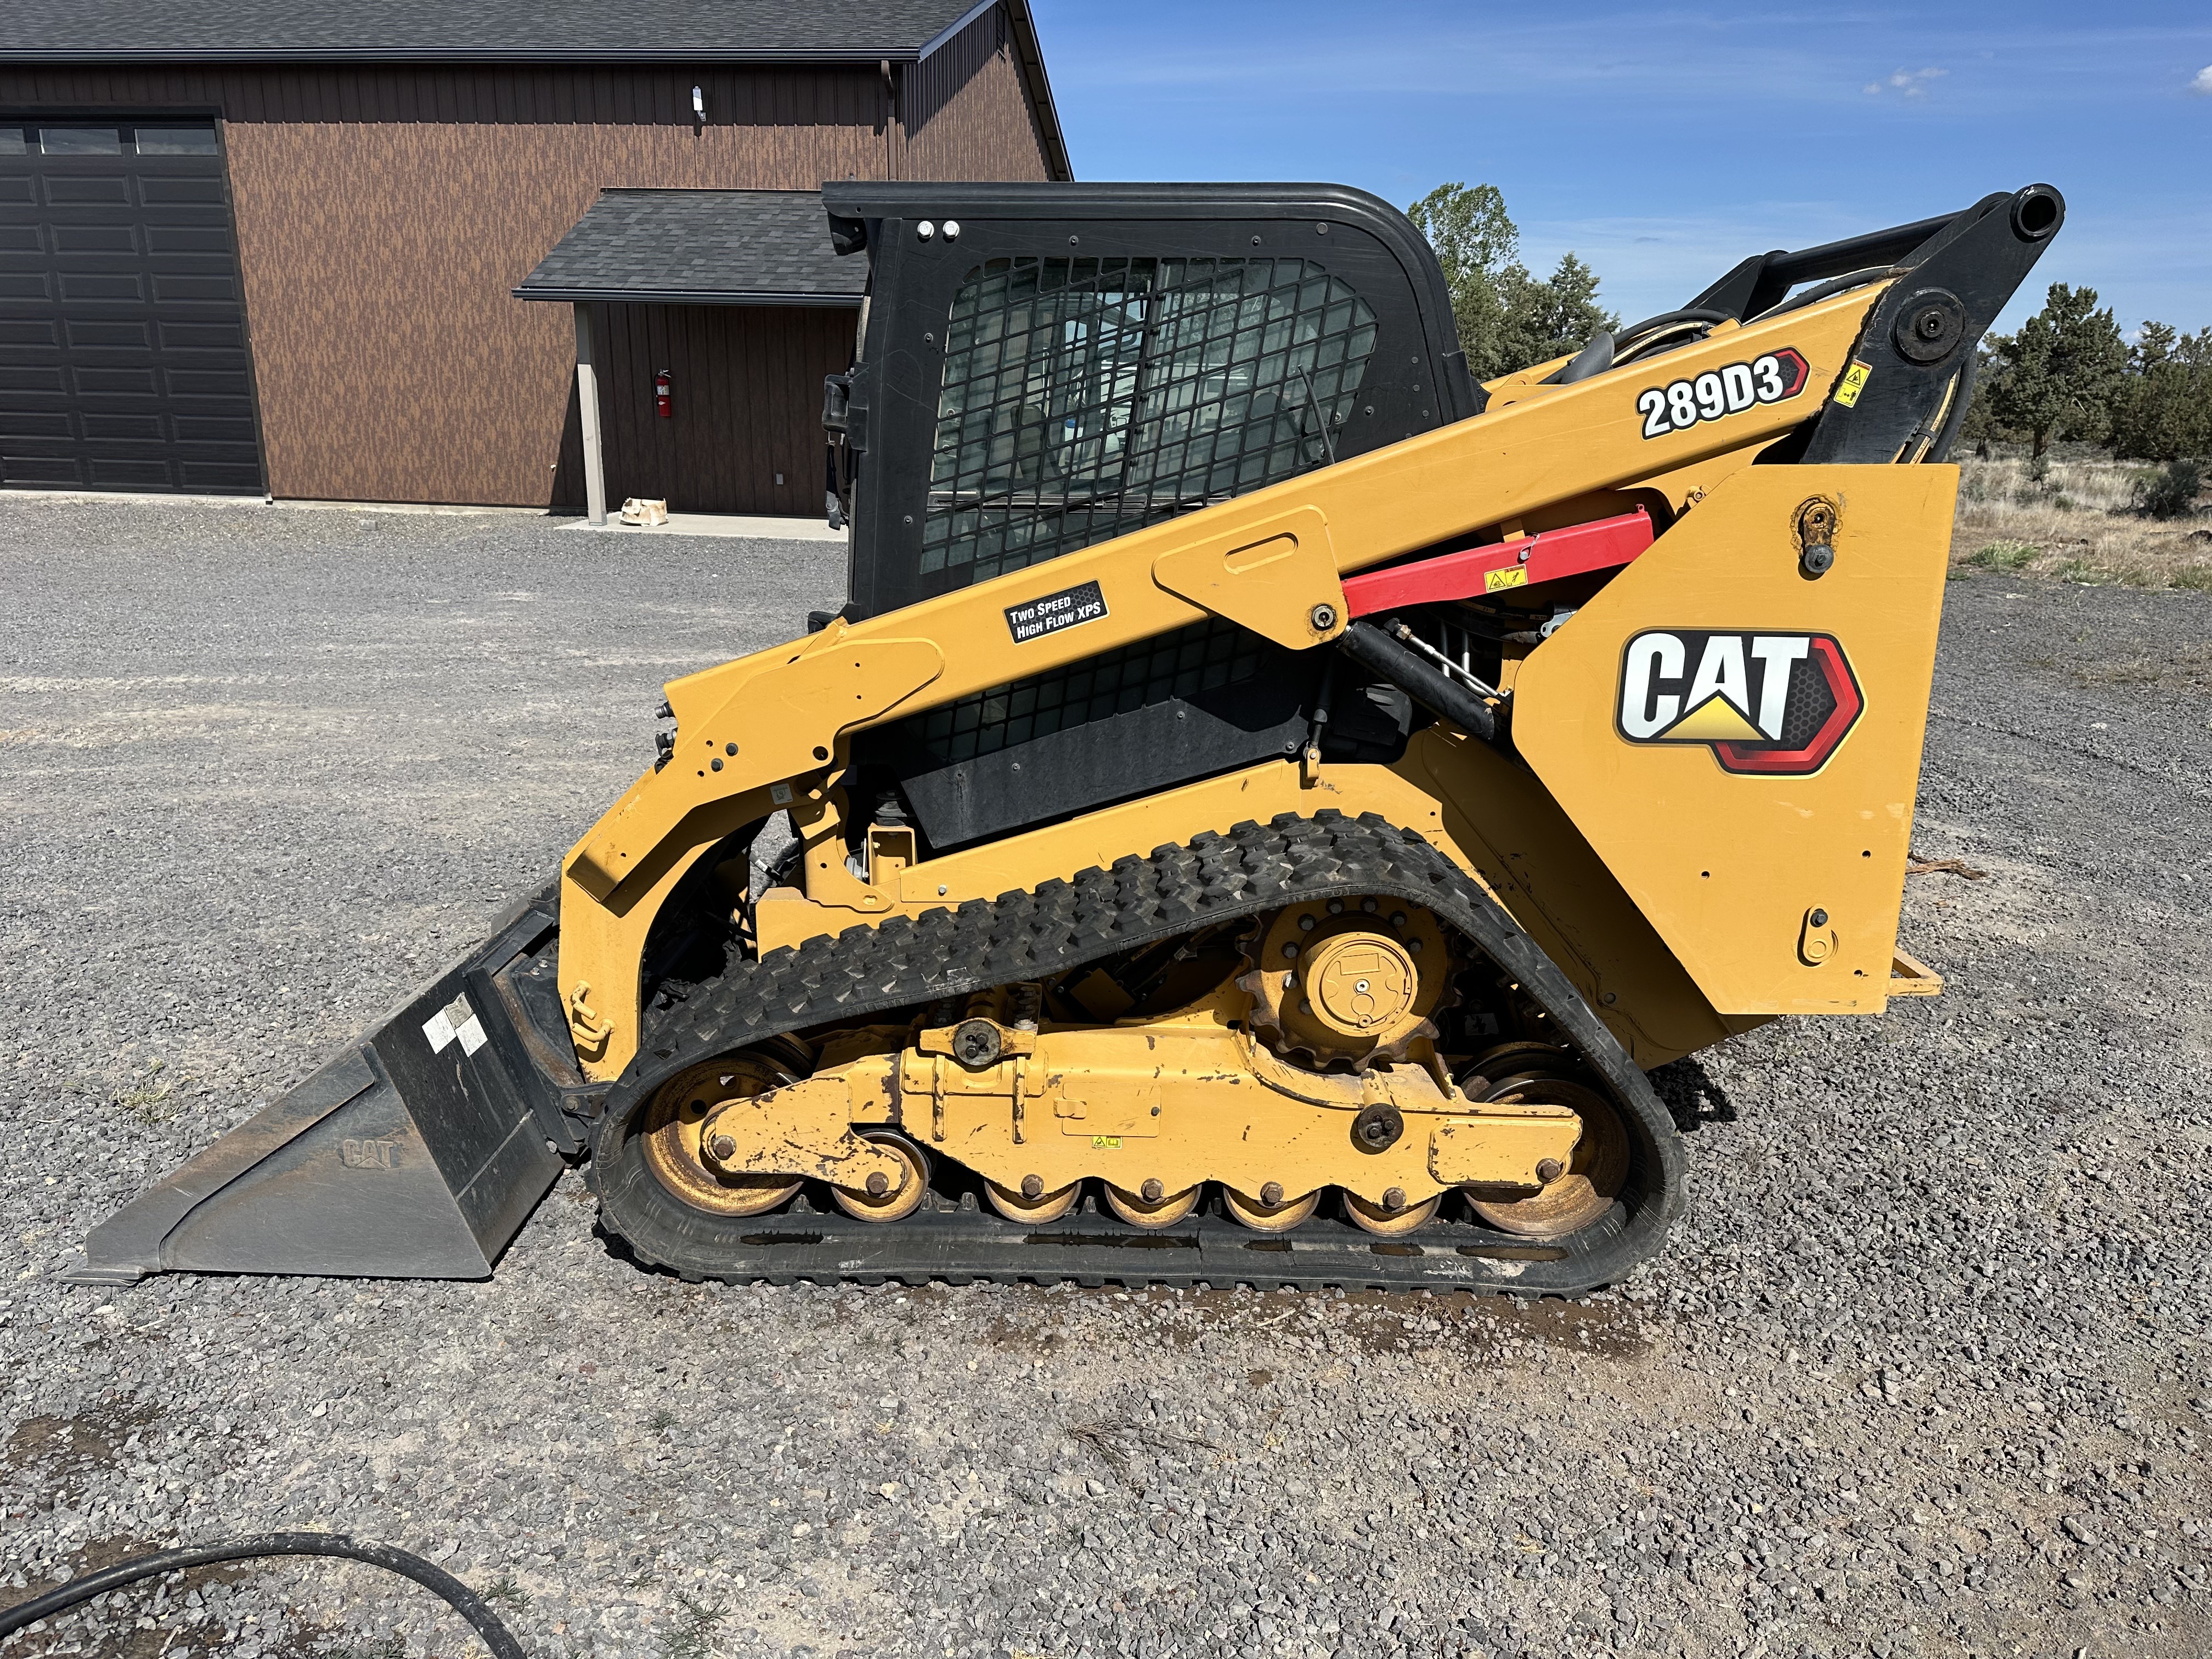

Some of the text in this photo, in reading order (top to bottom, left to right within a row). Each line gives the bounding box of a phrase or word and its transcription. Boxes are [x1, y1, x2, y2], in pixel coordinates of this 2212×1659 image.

[1639, 356, 1784, 436] 289D3
[1077, 601, 1101, 620] XPS
[1621, 633, 1810, 741] CAT
[343, 1138, 394, 1168] CAT
